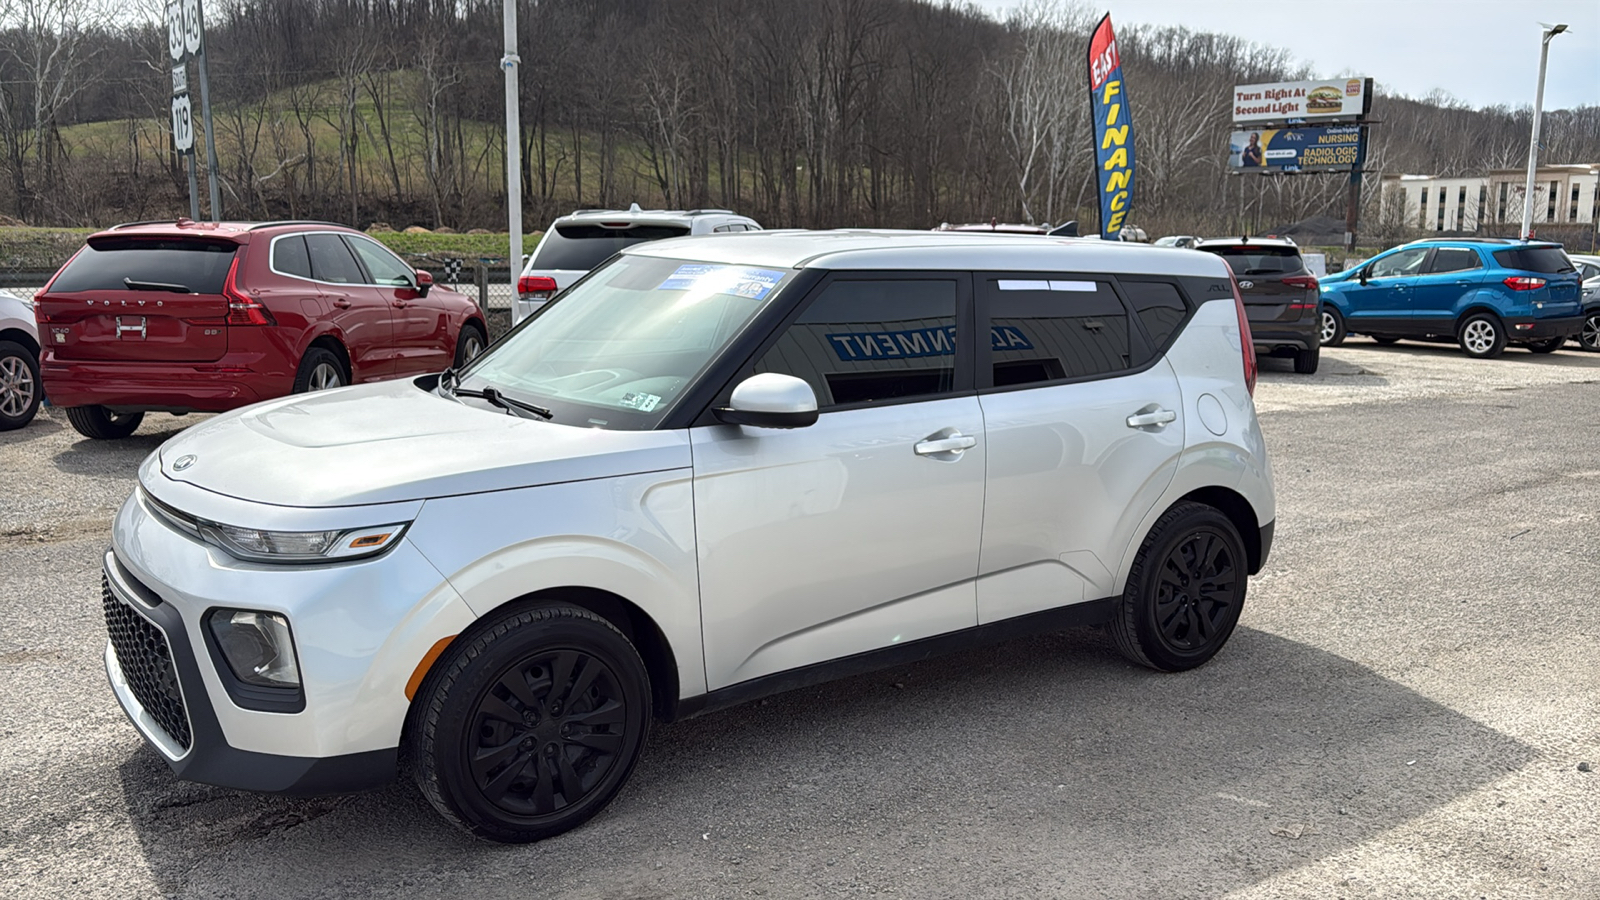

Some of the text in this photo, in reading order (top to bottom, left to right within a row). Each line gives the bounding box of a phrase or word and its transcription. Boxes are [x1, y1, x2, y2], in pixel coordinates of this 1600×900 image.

[171, 13, 183, 49] 33
[186, 4, 199, 41] 48
[1092, 40, 1116, 84] EASY
[1236, 87, 1306, 101] Turn Right At
[1235, 102, 1299, 115] Second Light
[175, 105, 189, 141] 119
[1318, 133, 1359, 144] NURSING
[1102, 80, 1132, 234] FINANCE
[1297, 154, 1358, 166] TECHNOLOGY
[1303, 146, 1358, 157] RADIOLOGIC
